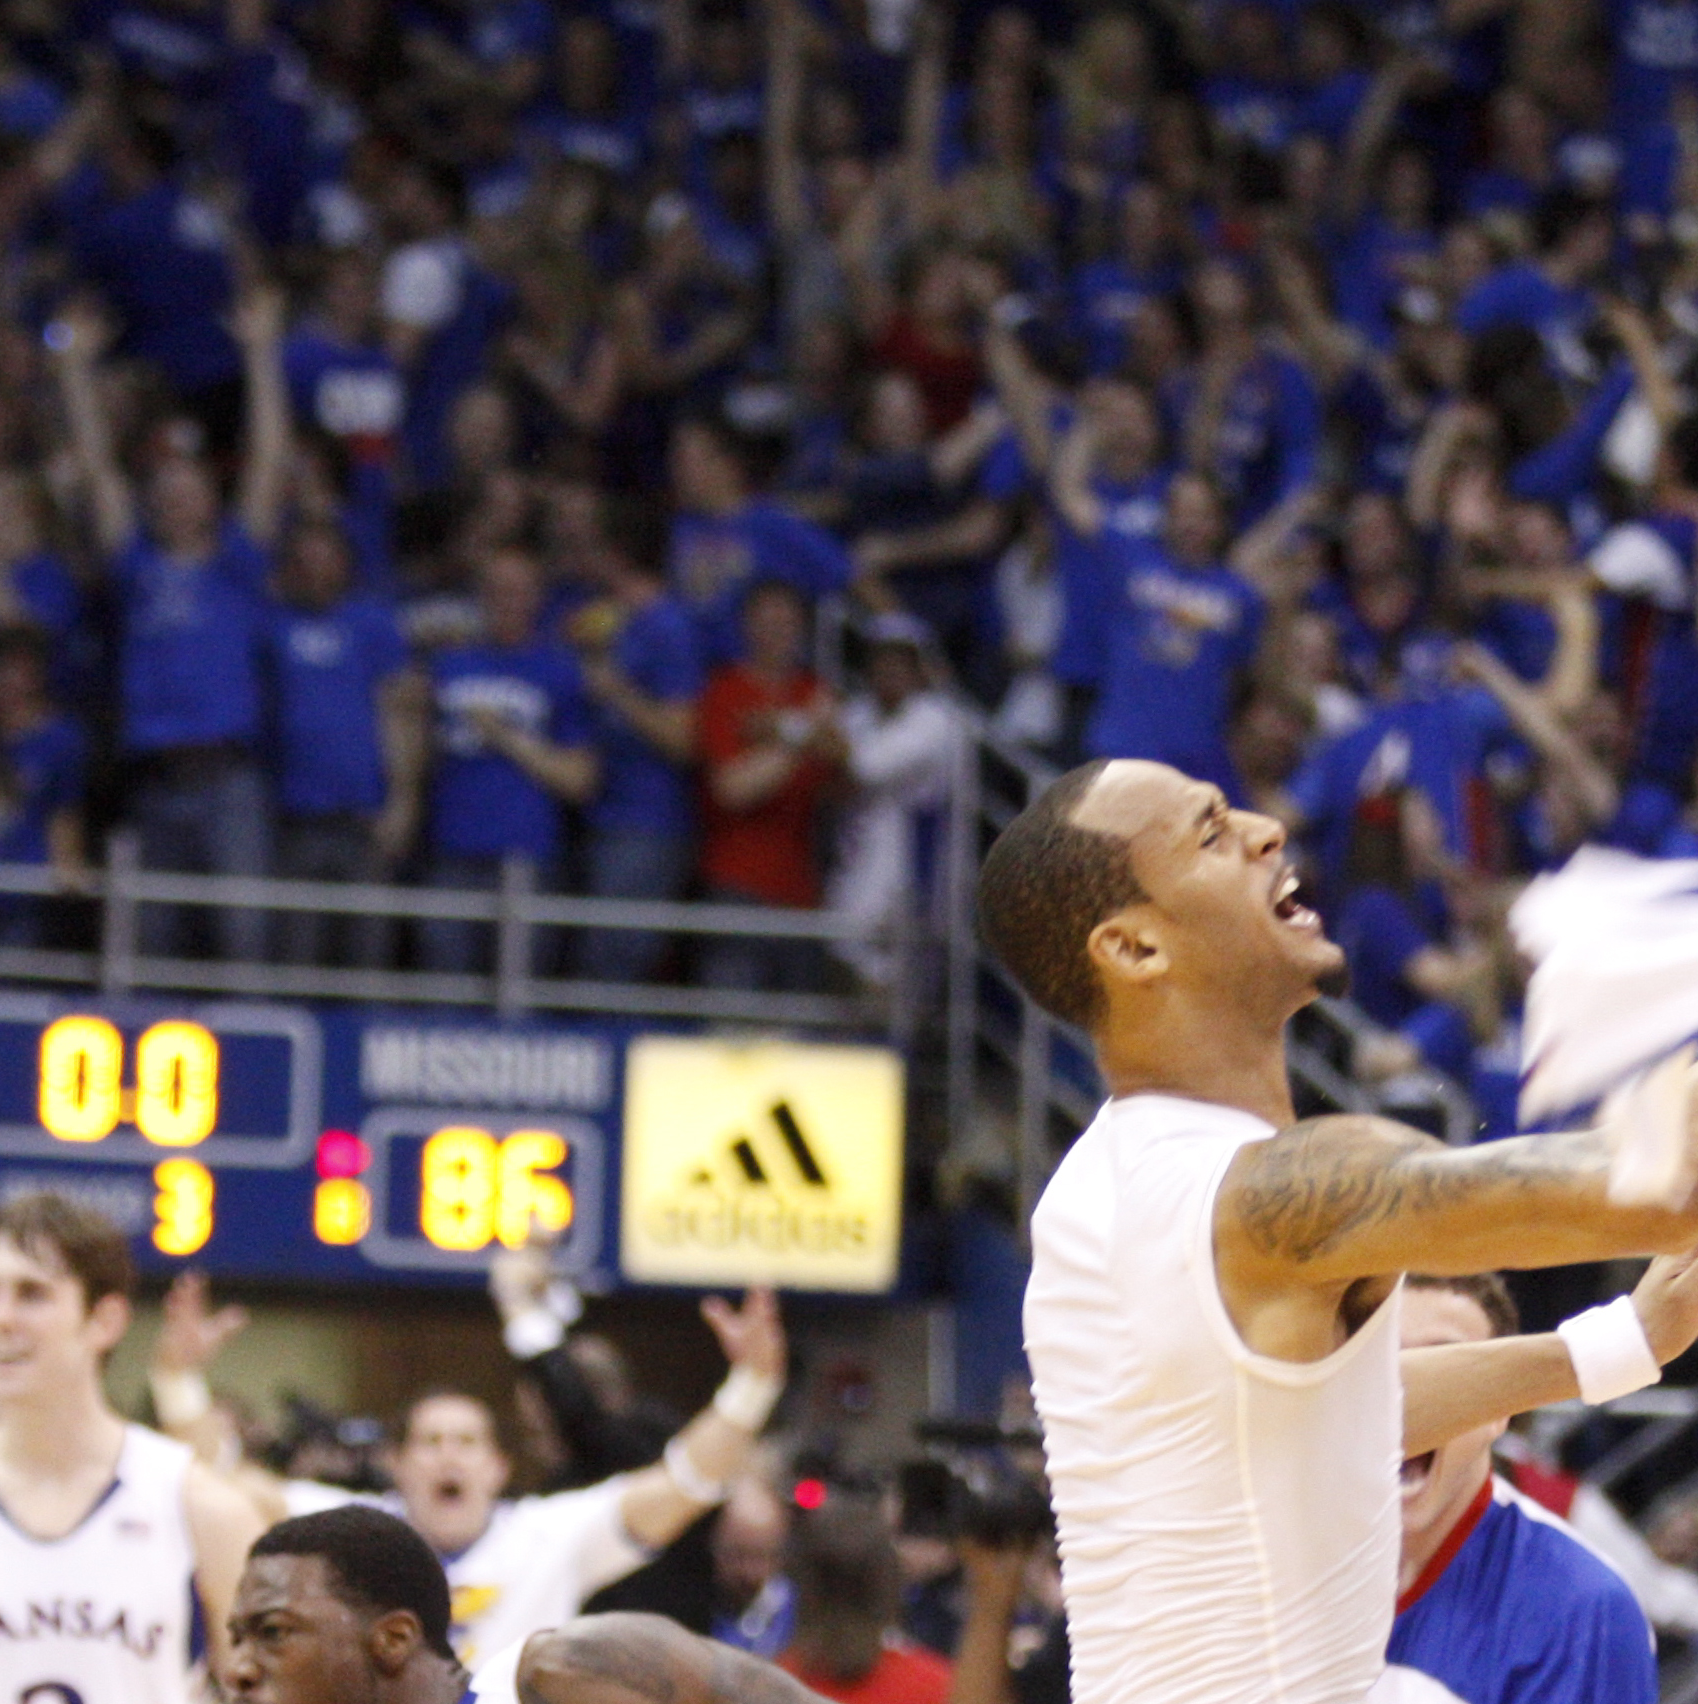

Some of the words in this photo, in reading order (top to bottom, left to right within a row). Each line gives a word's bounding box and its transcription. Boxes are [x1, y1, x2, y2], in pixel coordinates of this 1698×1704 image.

[362, 1029, 609, 1109] MISSOURI
[151, 1157, 214, 1256] 3
[420, 1126, 574, 1251] 86
